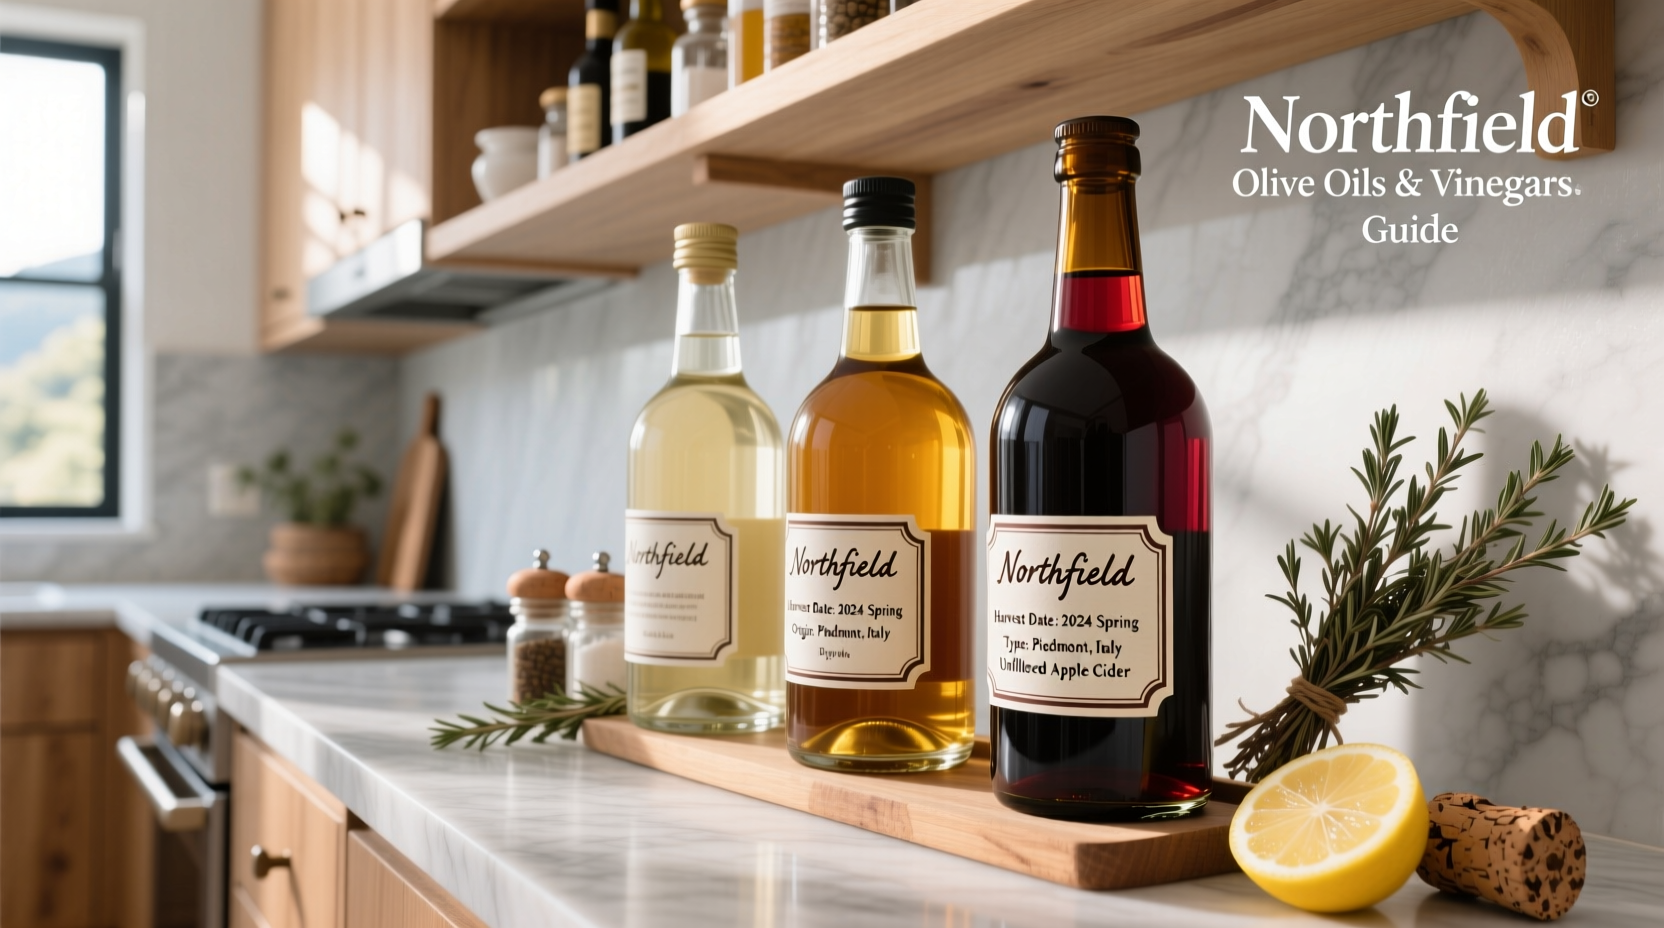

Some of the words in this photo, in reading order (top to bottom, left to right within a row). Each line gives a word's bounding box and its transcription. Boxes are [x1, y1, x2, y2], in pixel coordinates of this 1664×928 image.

[789, 545, 898, 591] Northfield
[997, 549, 1135, 601] Northfield
[838, 603, 864, 616] 2024
[867, 604, 903, 620] Spring
[1029, 612, 1058, 627] Date:
[1061, 613, 1092, 627] 2024
[1096, 614, 1139, 632] Spring
[867, 625, 891, 642] Italy
[1050, 662, 1089, 681] Apple
[1093, 662, 1131, 678] Cider
